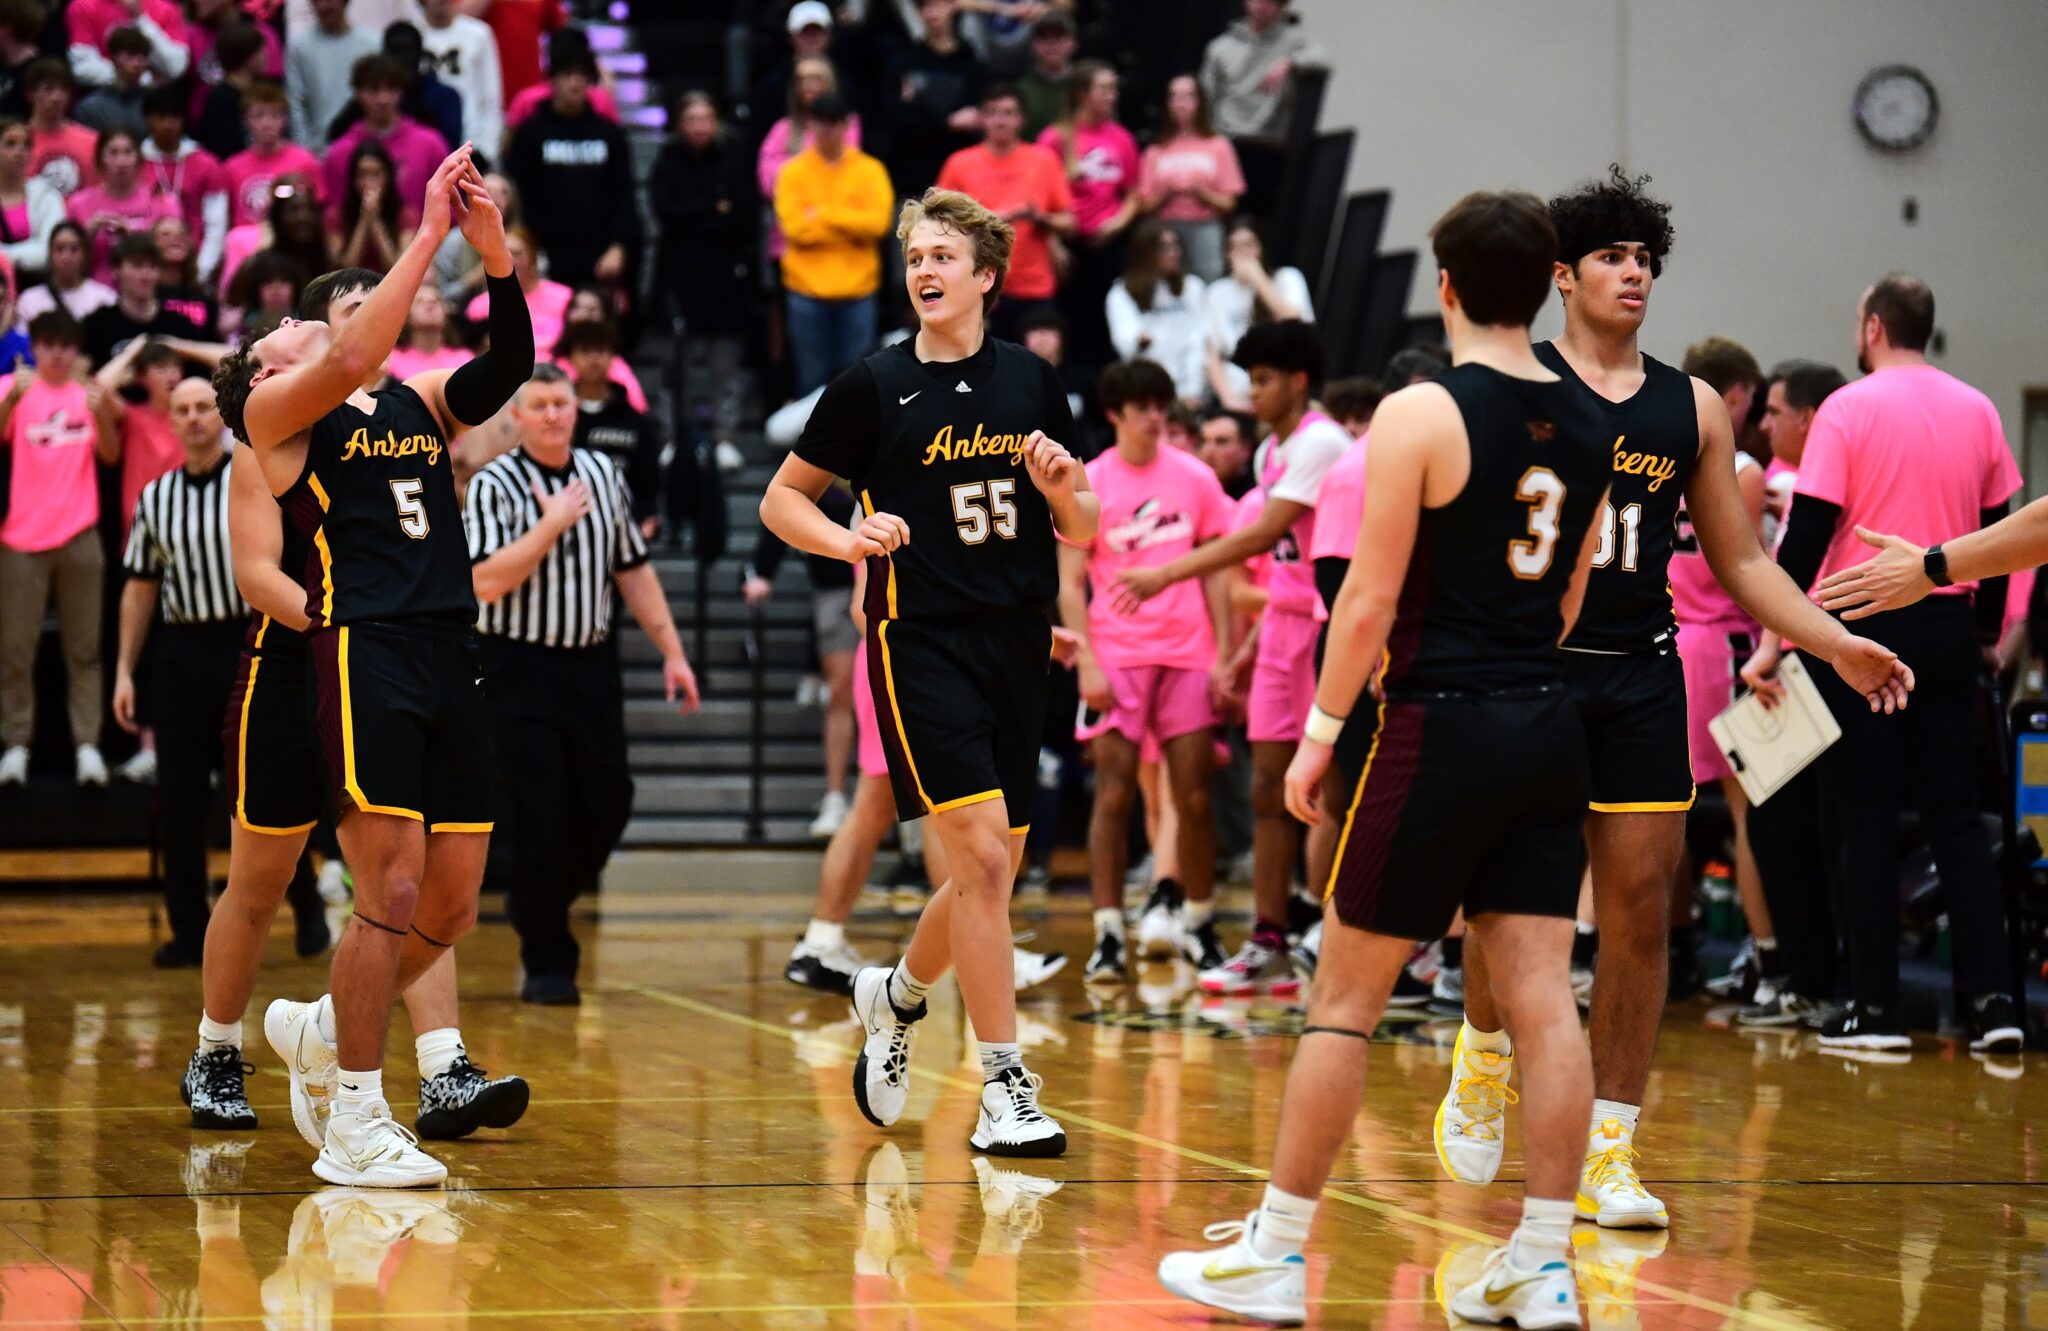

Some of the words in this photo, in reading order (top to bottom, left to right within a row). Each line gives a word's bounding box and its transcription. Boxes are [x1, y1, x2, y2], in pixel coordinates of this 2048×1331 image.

[341, 427, 443, 466] Ankeny
[923, 423, 1029, 467] Ankeny
[1612, 435, 1676, 493] keny
[388, 477, 431, 540] 5
[950, 478, 1019, 546] 55
[1506, 465, 1567, 581] 3
